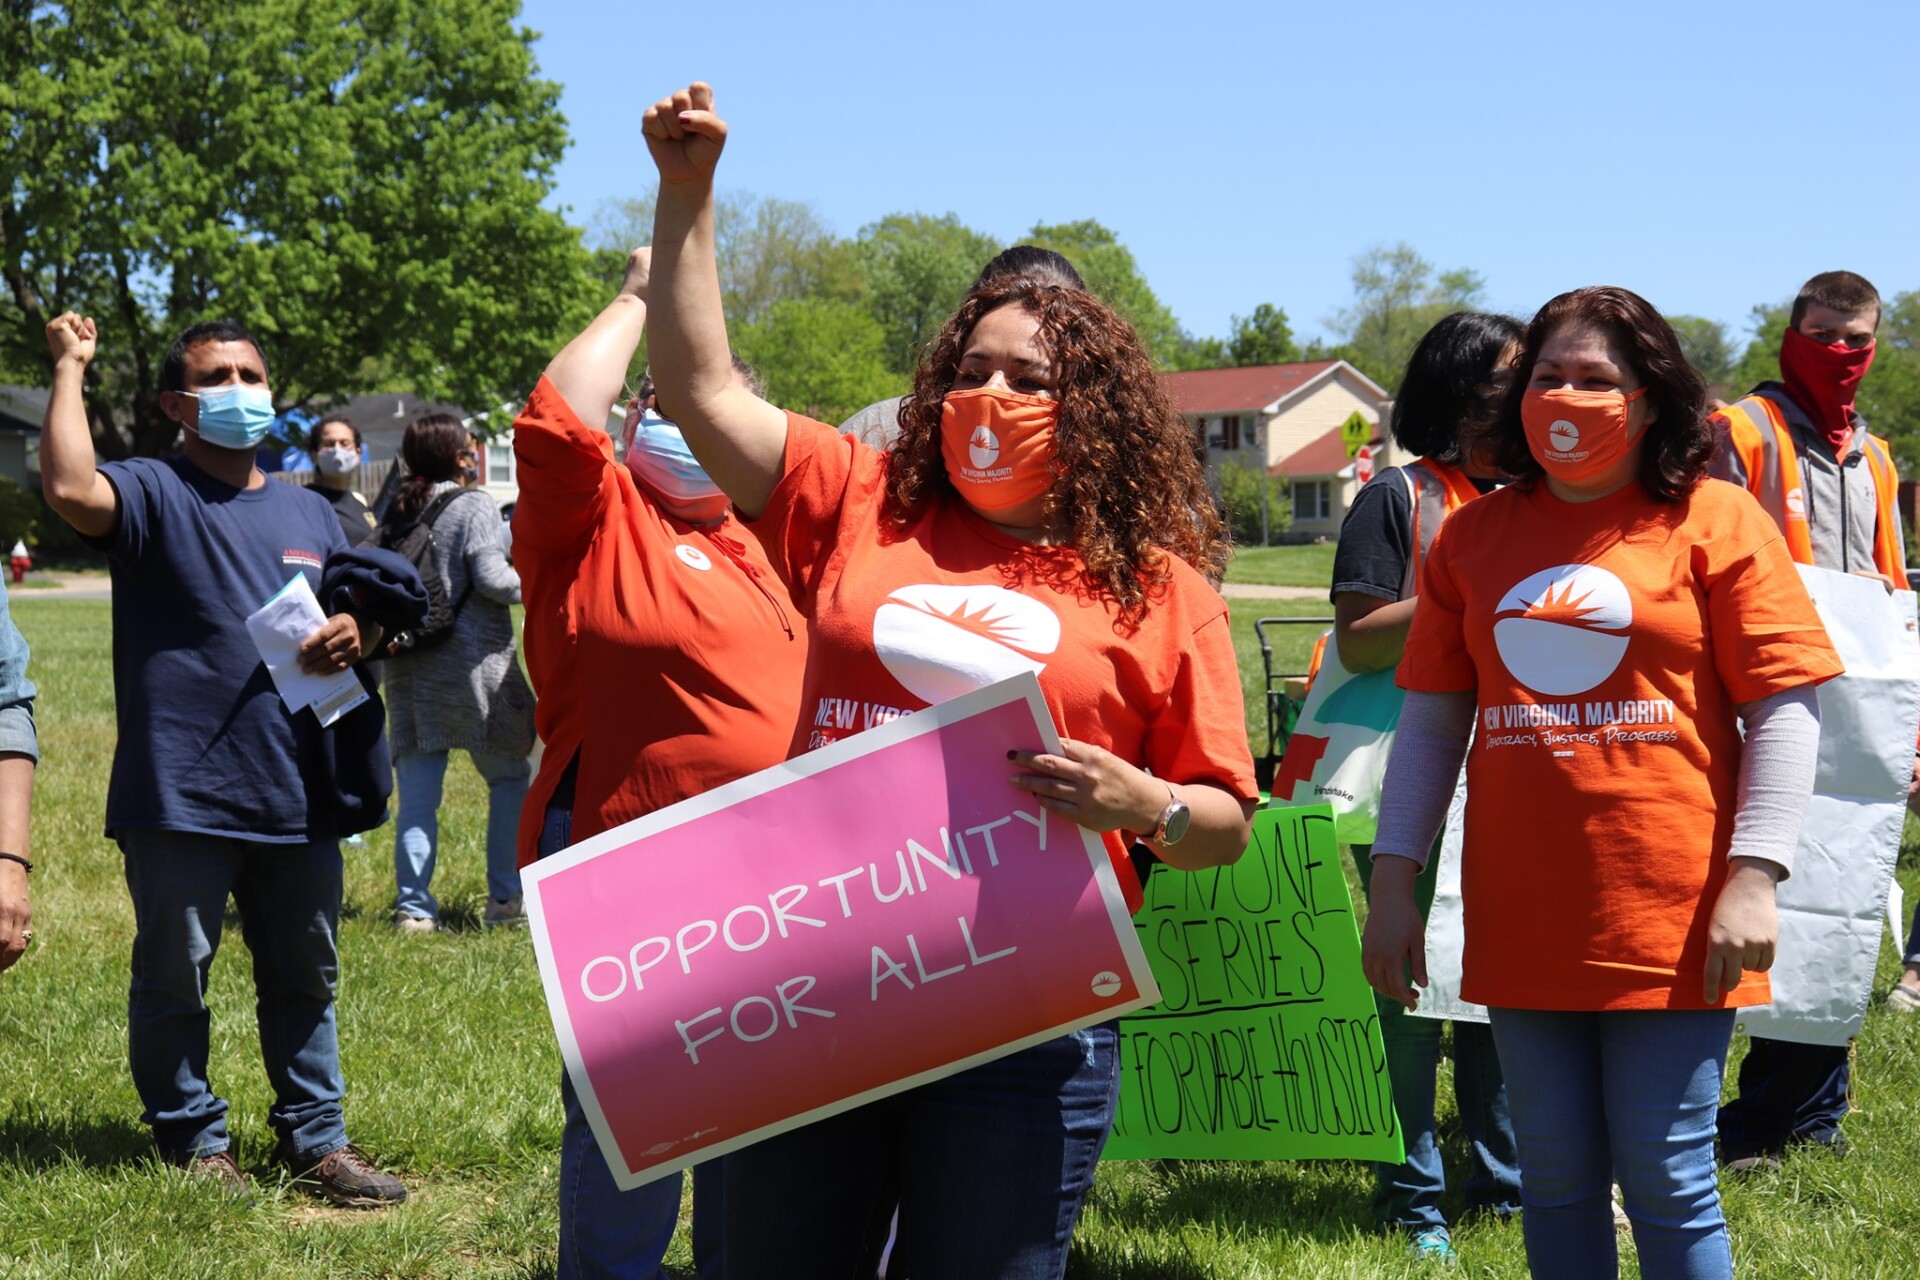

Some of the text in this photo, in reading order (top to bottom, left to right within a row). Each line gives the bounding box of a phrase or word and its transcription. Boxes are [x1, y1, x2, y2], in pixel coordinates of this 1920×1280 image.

[814, 697, 858, 730] NEW
[1503, 703, 1580, 728] VIRGINIA
[1585, 700, 1675, 725] MAJORITY
[580, 806, 1048, 1003] OPPORTUNITY
[674, 915, 1018, 1065] FOR ALL
[1134, 911, 1324, 1012] SERVES
[1111, 1026, 1280, 1136] FORDABLE
